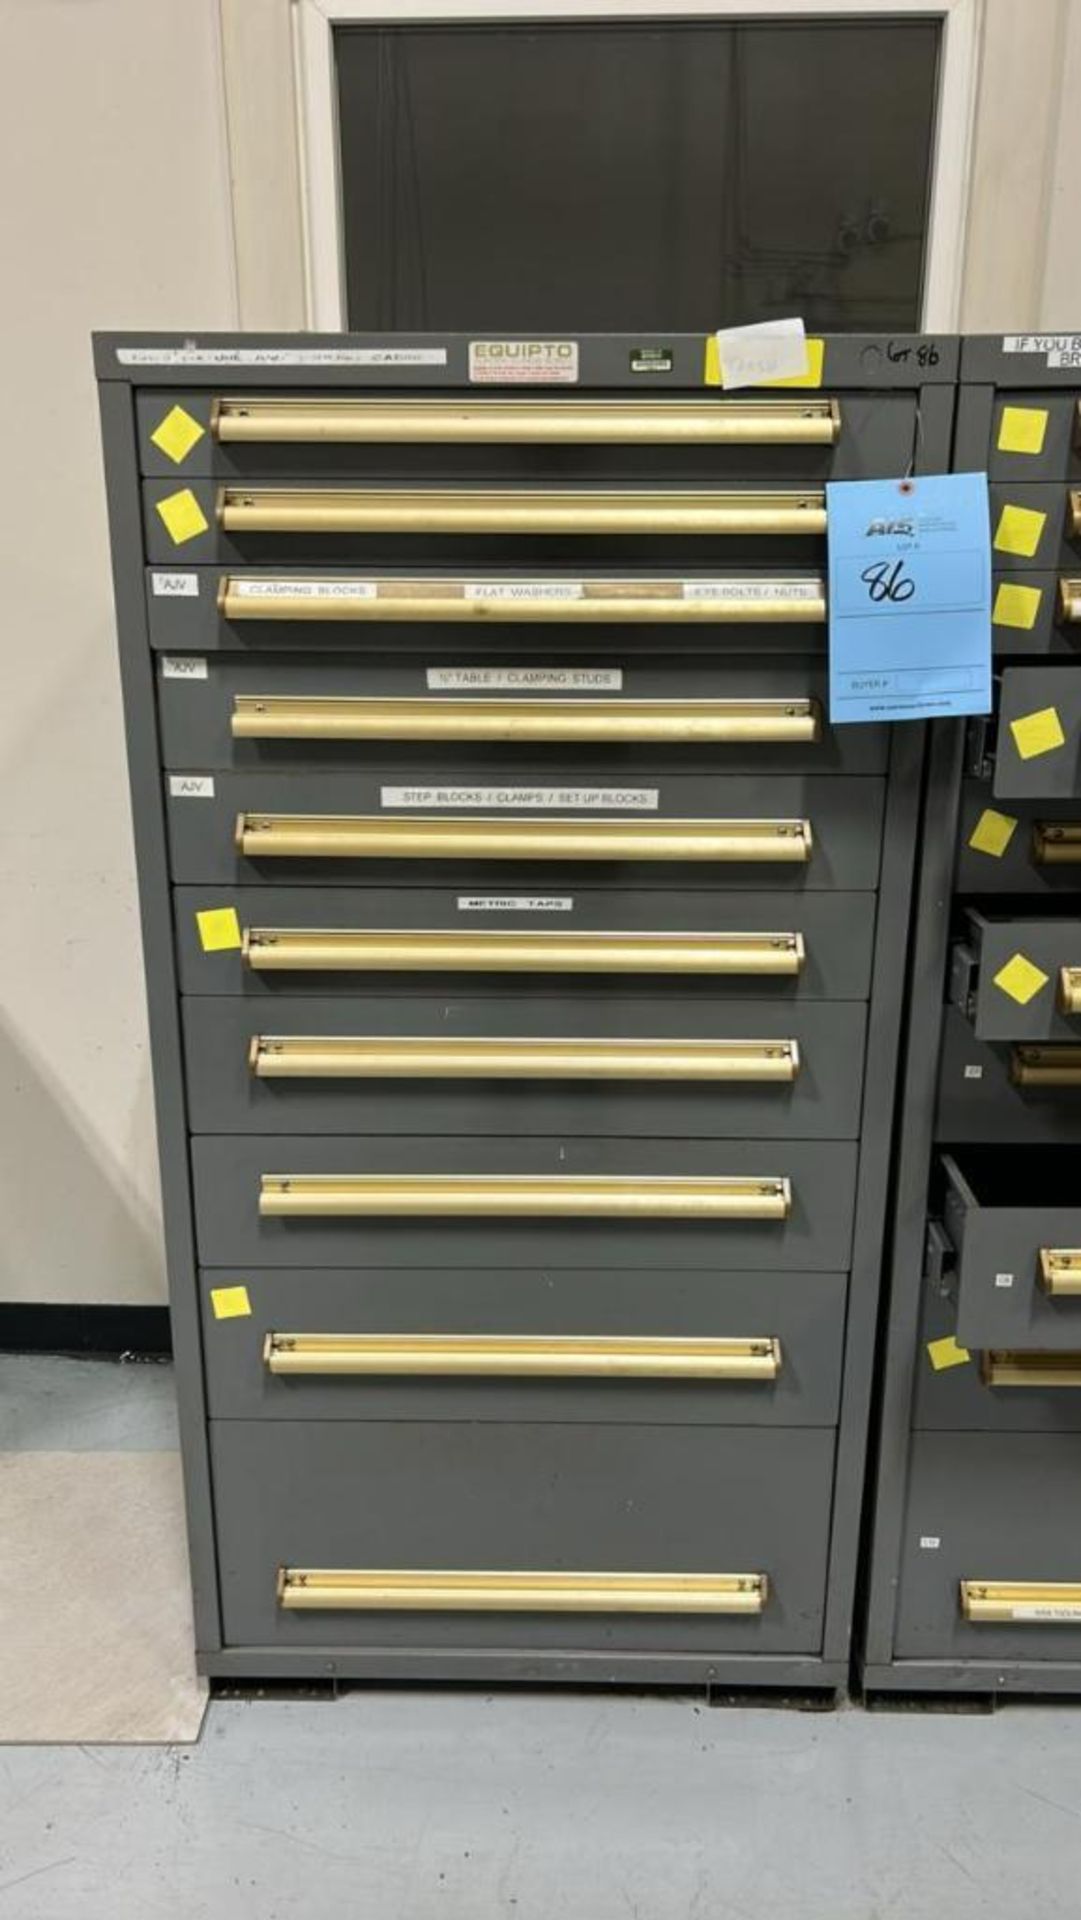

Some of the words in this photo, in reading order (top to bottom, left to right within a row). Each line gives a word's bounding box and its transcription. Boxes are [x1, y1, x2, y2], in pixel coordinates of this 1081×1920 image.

[474, 343, 573, 358] EQUIPTO
[1015, 338, 1029, 350] IF
[1033, 338, 1067, 351] YOU
[916, 344, 939, 367] 86
[861, 559, 915, 602] 86
[248, 584, 313, 595] CLAMPING
[317, 585, 367, 595] BLOCKS
[474, 586, 505, 597] FLAT
[510, 586, 572, 597] WASHERS
[773, 587, 808, 597] NUTS
[507, 672, 567, 684] CLAMPING
[573, 673, 612, 685] STUDS
[403, 791, 432, 803] STEP
[436, 791, 483, 803] BLOCKS
[496, 792, 544, 804] CLAMPS
[558, 793, 580, 804] SET
[583, 793, 600, 804] UP
[601, 793, 648, 805] BLOCKS
[468, 899, 517, 908] METRIC
[529, 899, 563, 908] TAPS
